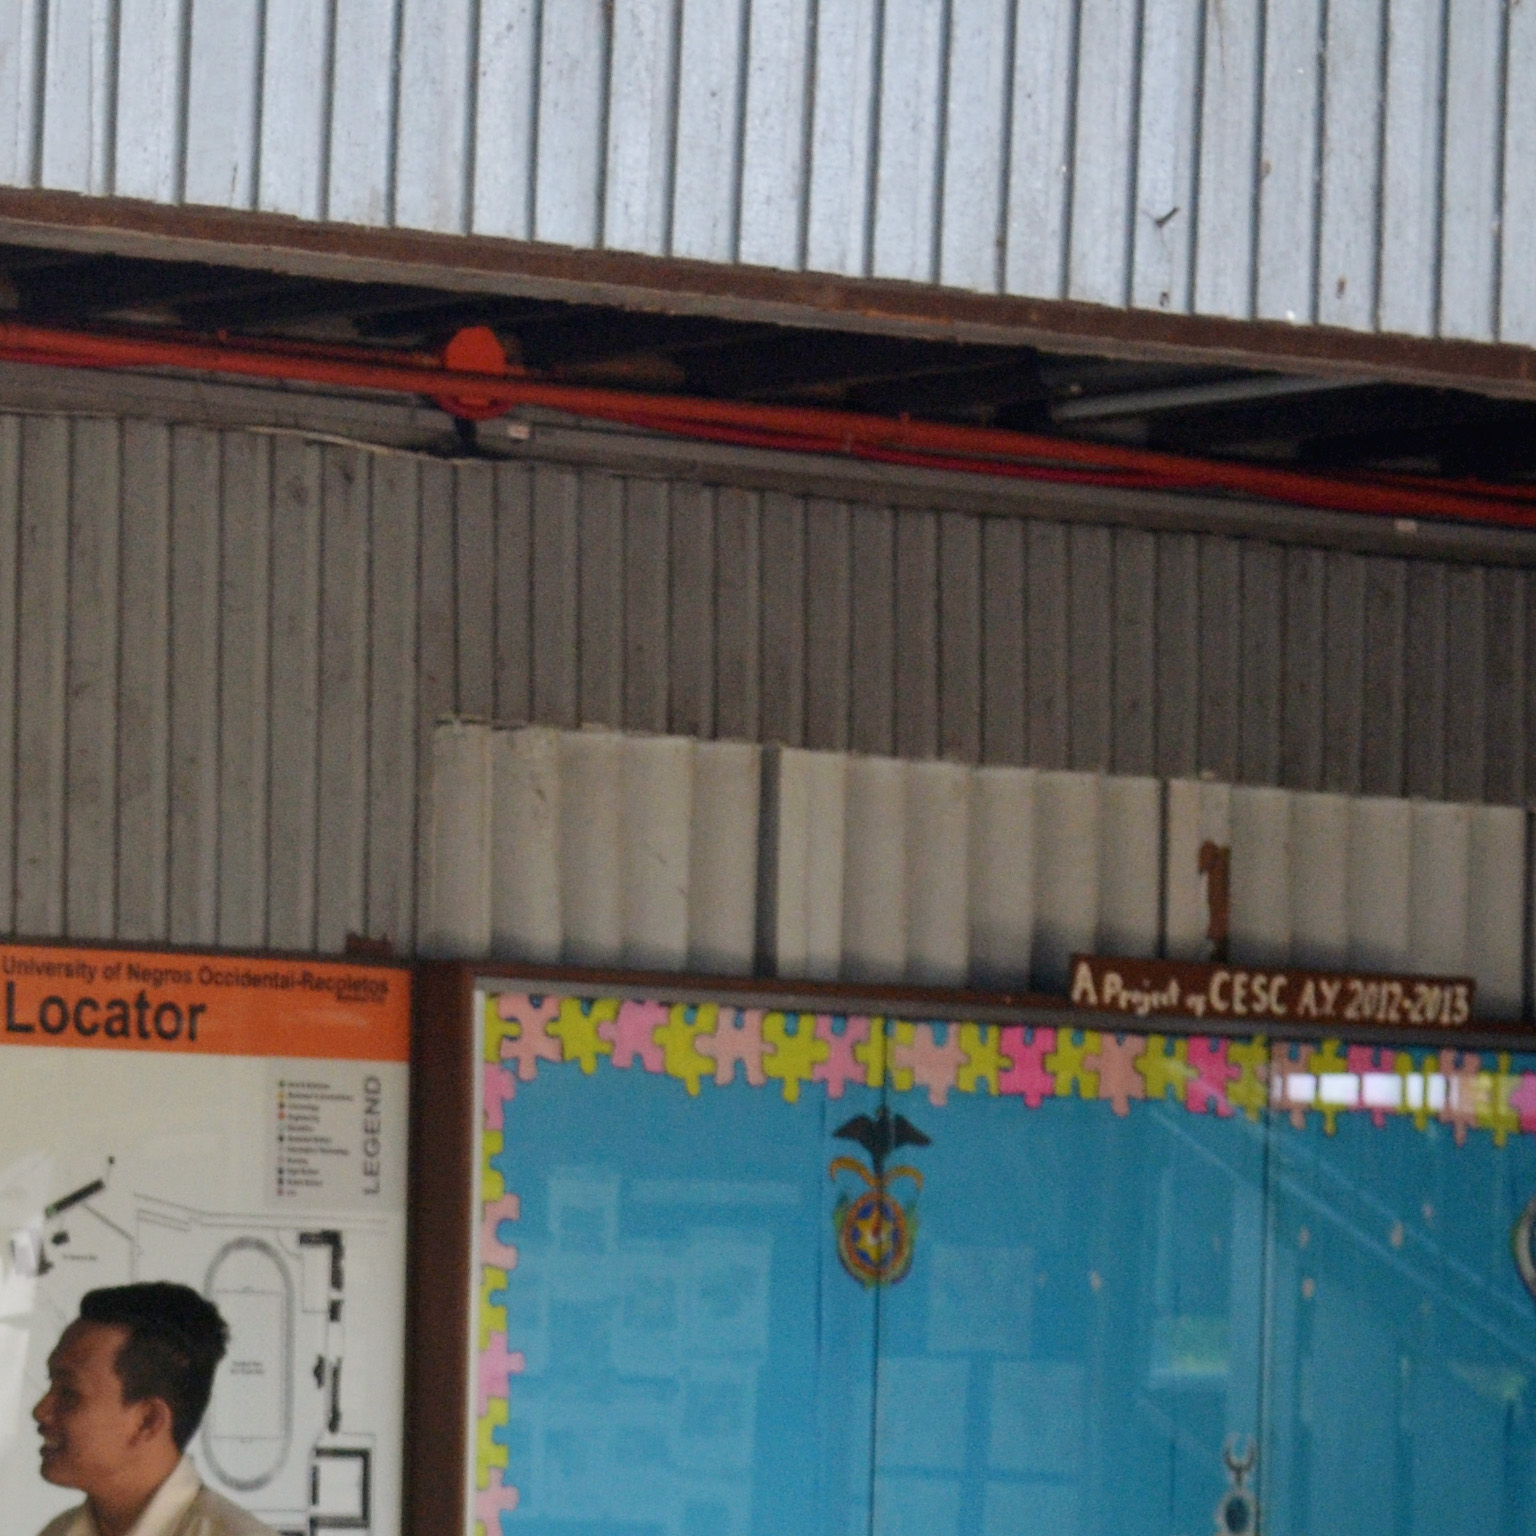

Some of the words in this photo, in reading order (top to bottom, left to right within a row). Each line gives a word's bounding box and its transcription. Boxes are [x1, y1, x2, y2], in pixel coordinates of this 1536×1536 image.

[3, 955, 96, 984] University
[102, 962, 123, 979] of
[127, 963, 192, 988] Negros
[1071, 961, 1097, 1006] A
[1209, 970, 1289, 1015] CESC
[4, 979, 205, 1042] Locator
[363, 1075, 381, 1196] LEGEND
